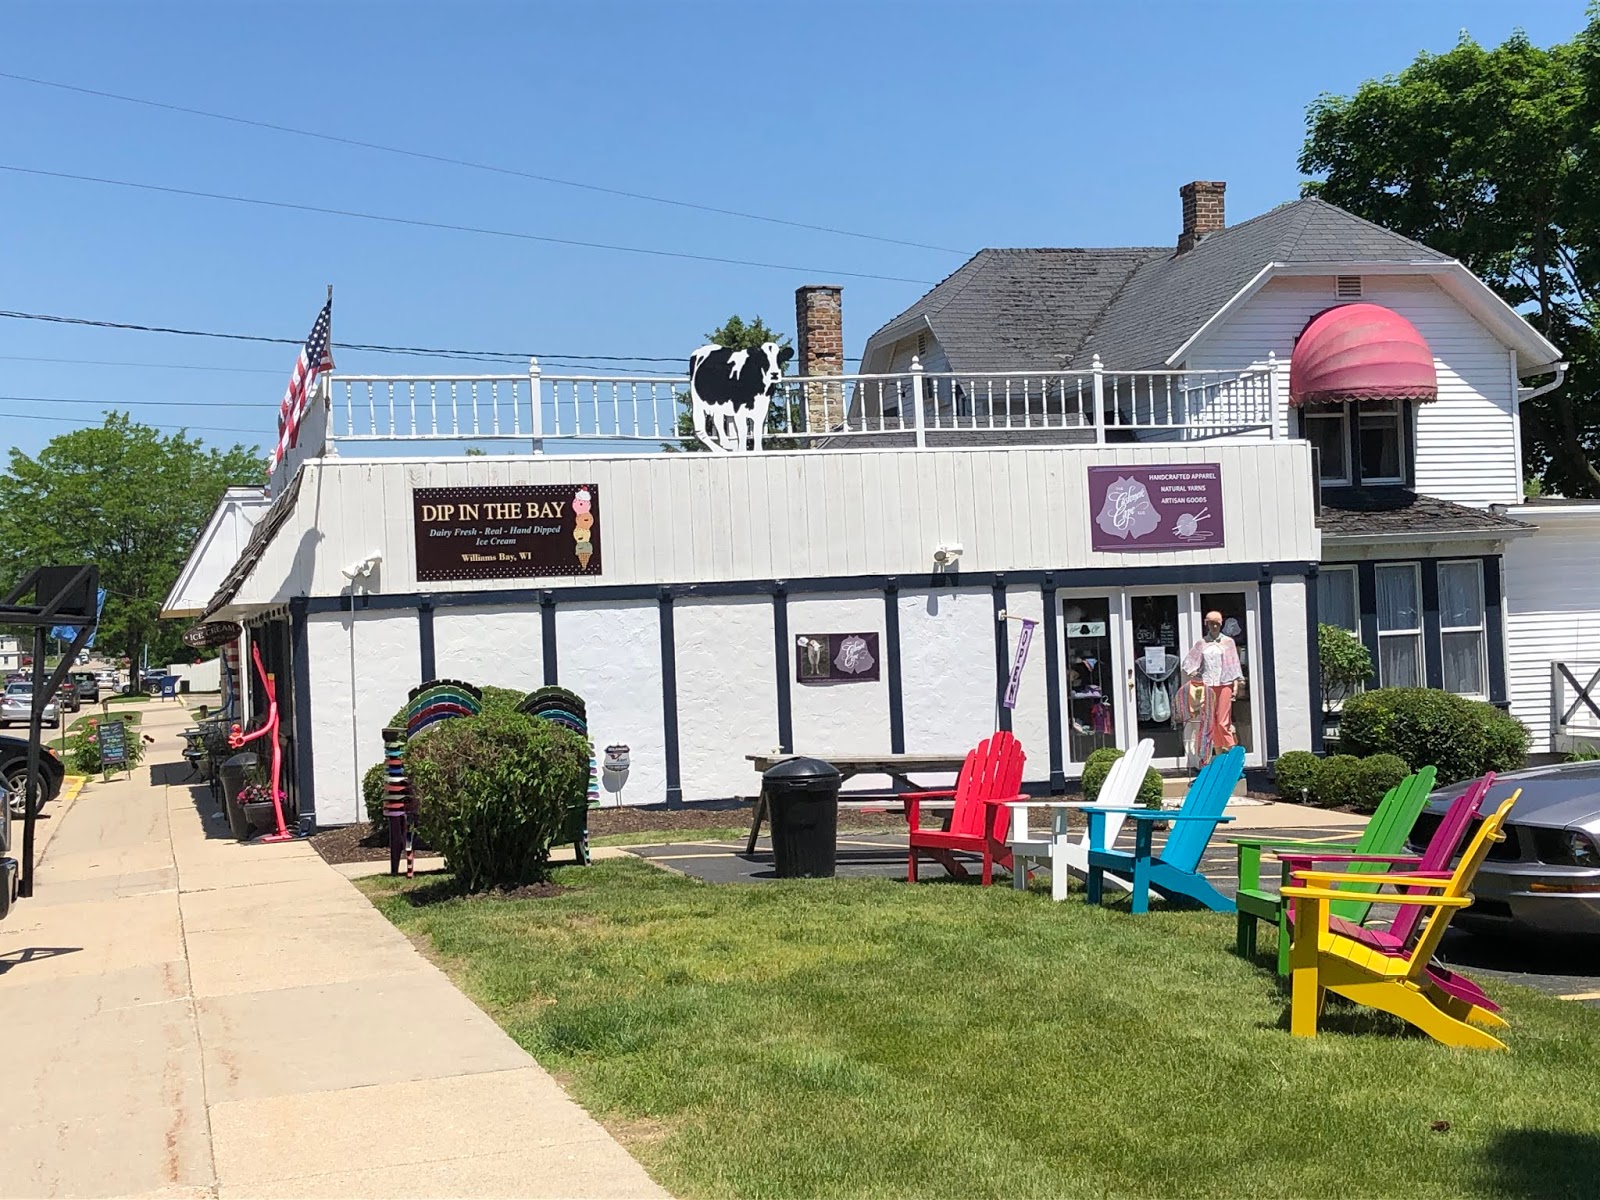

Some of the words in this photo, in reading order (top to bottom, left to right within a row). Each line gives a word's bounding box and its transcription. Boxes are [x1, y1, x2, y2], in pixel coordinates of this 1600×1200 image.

[1148, 473, 1190, 481] HANDCRAFTED
[421, 504, 454, 522] DIP
[458, 503, 479, 521] IN
[483, 502, 523, 520] THE
[525, 501, 566, 519] BAY
[429, 528, 452, 538] Dairy
[454, 527, 477, 536] Fresh
[484, 527, 503, 536] Real
[509, 526, 532, 535] Hand
[533, 525, 561, 535] Dipped
[475, 537, 489, 546] Ice
[490, 537, 516, 545] Cream
[461, 553, 497, 562] Williams
[499, 552, 517, 562] Bay,
[519, 551, 532, 560] WI
[190, 631, 205, 641] ICE
[205, 624, 236, 636] CREAM
[1008, 630, 1028, 701] OPEN
